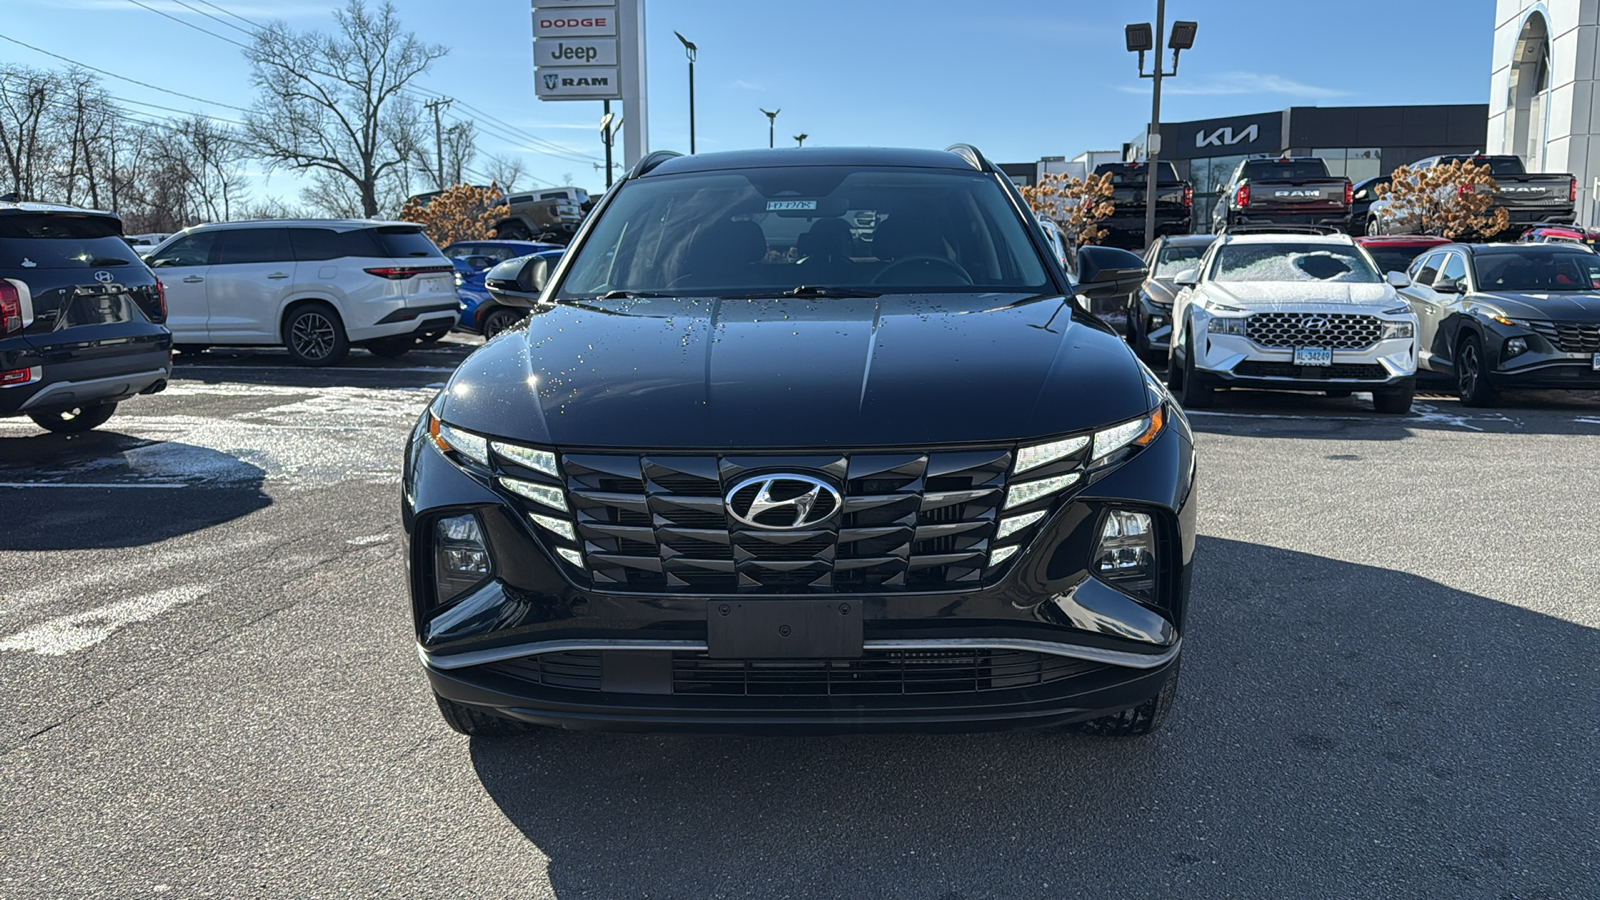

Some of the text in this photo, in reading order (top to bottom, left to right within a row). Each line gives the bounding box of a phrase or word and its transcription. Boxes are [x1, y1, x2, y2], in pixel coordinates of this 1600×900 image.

[540, 18, 607, 28] DODGE
[551, 43, 597, 62] Jeep
[562, 77, 608, 86] RAM
[1195, 124, 1258, 147] KIA
